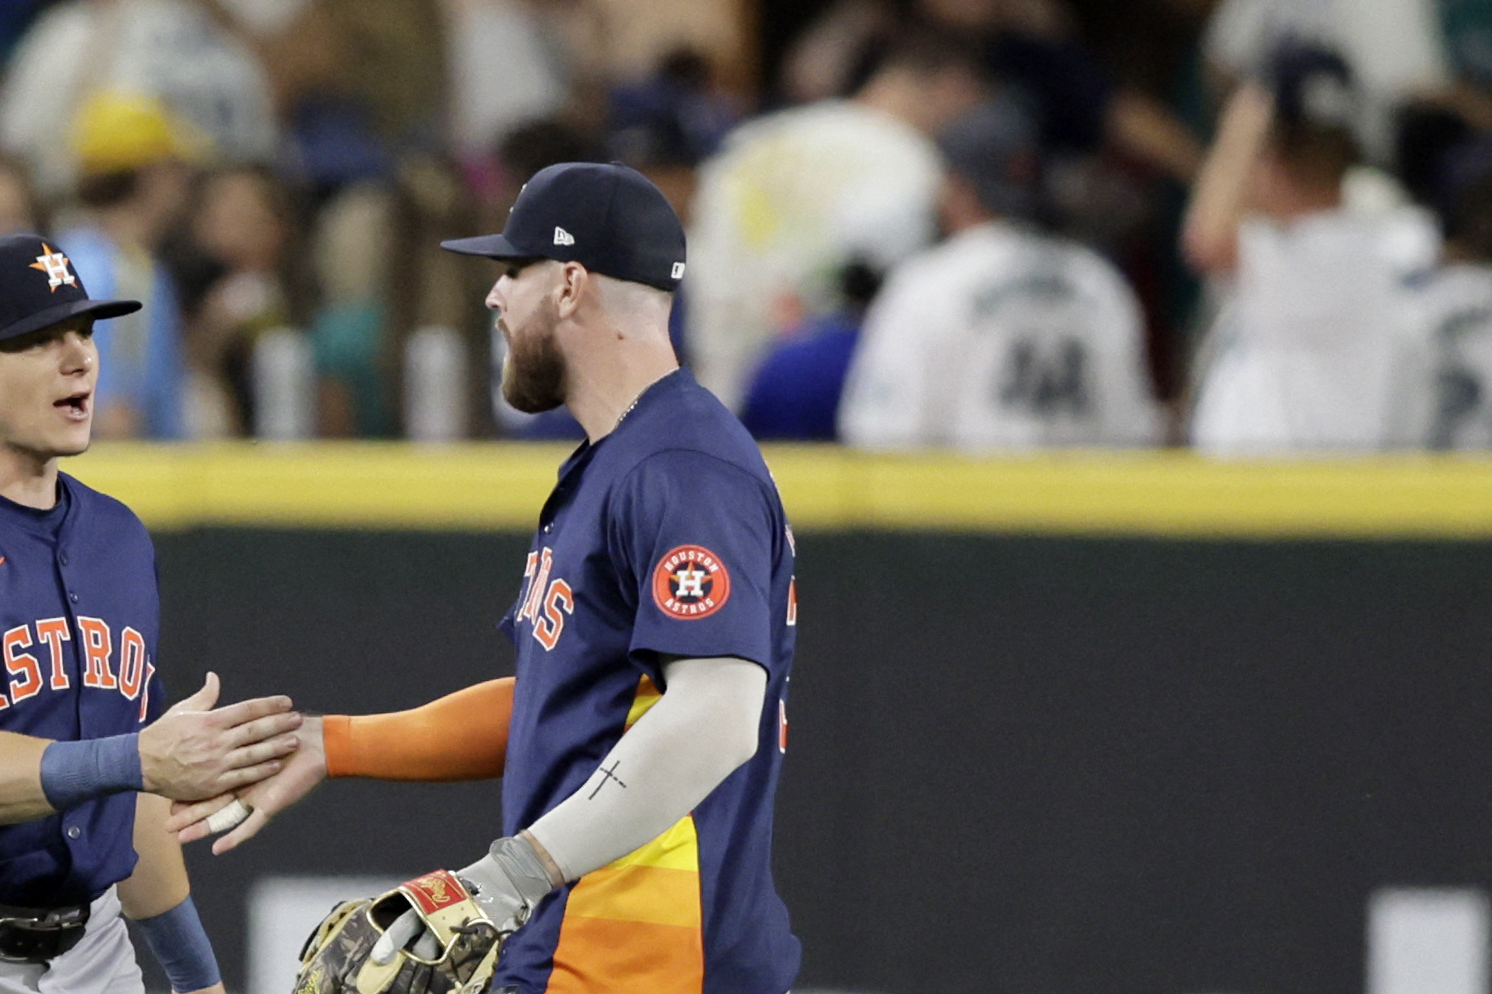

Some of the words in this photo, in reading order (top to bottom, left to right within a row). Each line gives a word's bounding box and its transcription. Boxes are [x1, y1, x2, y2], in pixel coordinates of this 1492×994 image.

[36, 252, 75, 286] H
[664, 550, 719, 573] HOUSTON
[675, 570, 706, 597] H
[664, 597, 715, 614] ASTROS
